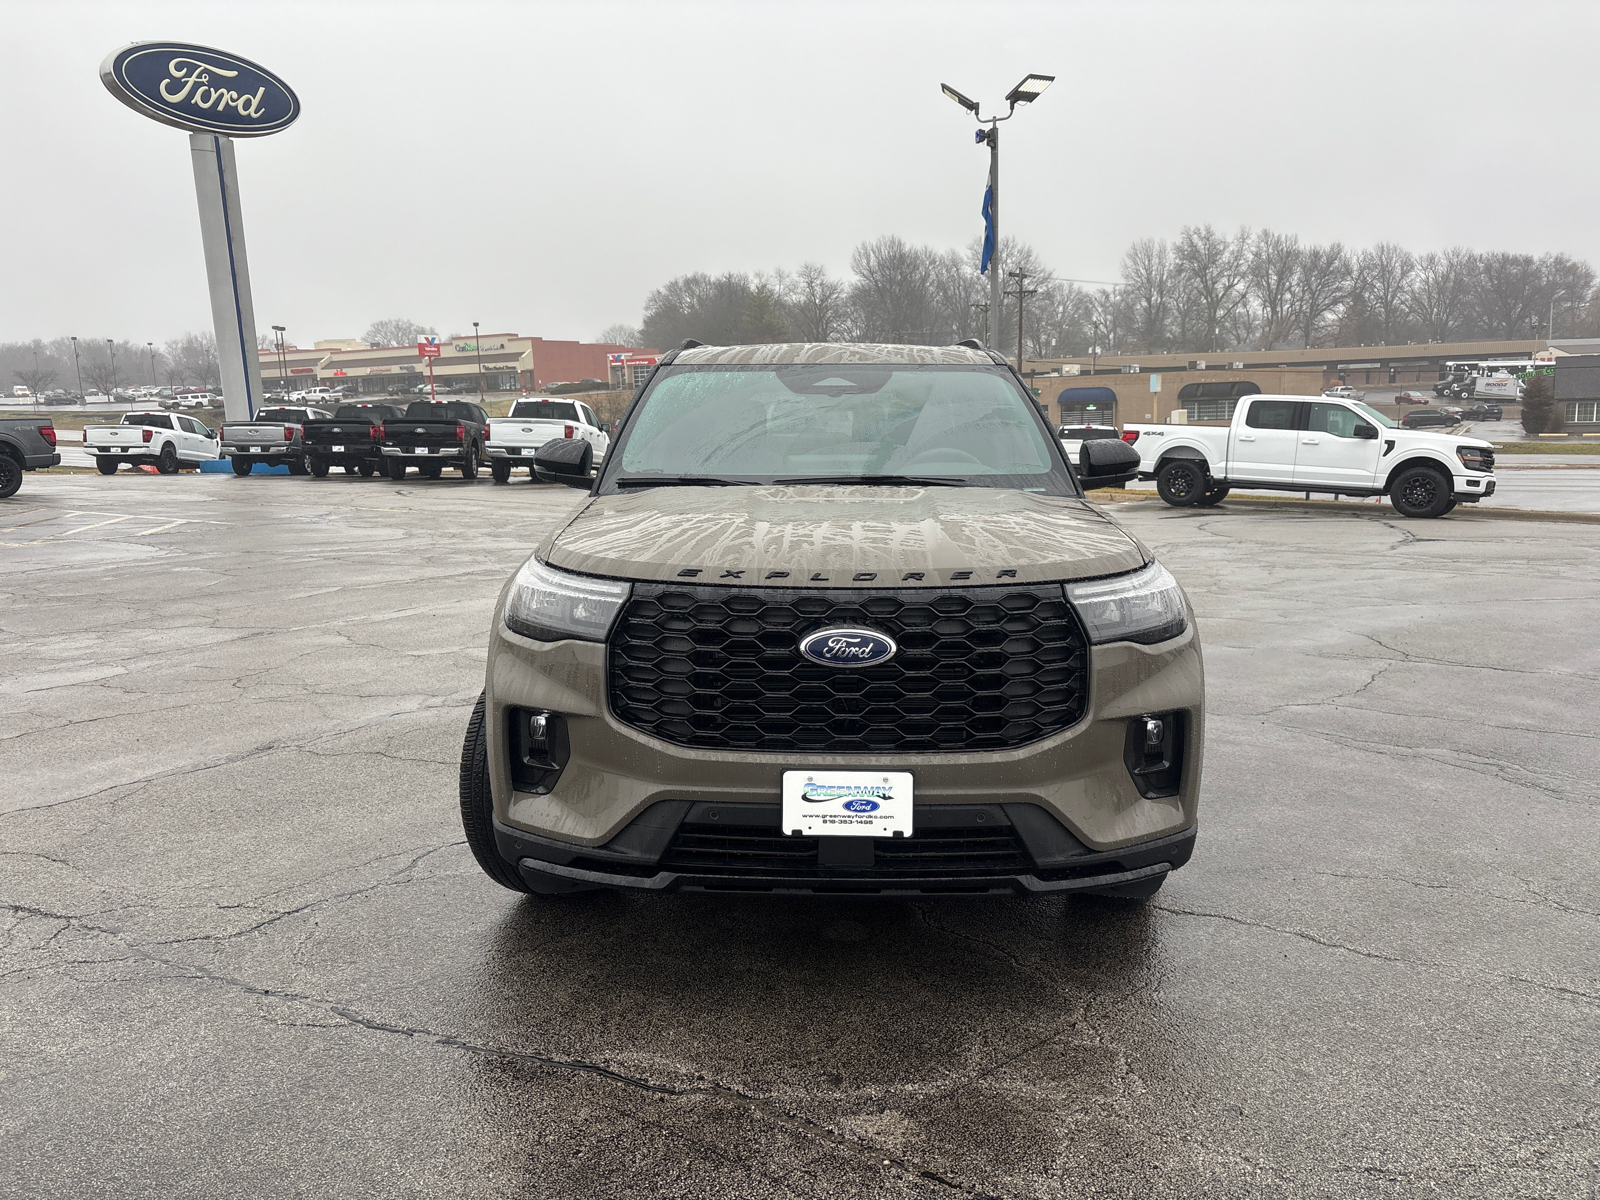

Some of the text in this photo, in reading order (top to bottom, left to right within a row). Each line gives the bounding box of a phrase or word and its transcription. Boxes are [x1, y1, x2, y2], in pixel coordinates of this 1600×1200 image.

[159, 57, 266, 119] Ford
[677, 568, 1018, 582] EXPLORER
[822, 637, 874, 659] Ford
[803, 782, 893, 798] GREENWAY
[850, 800, 872, 811] Ford
